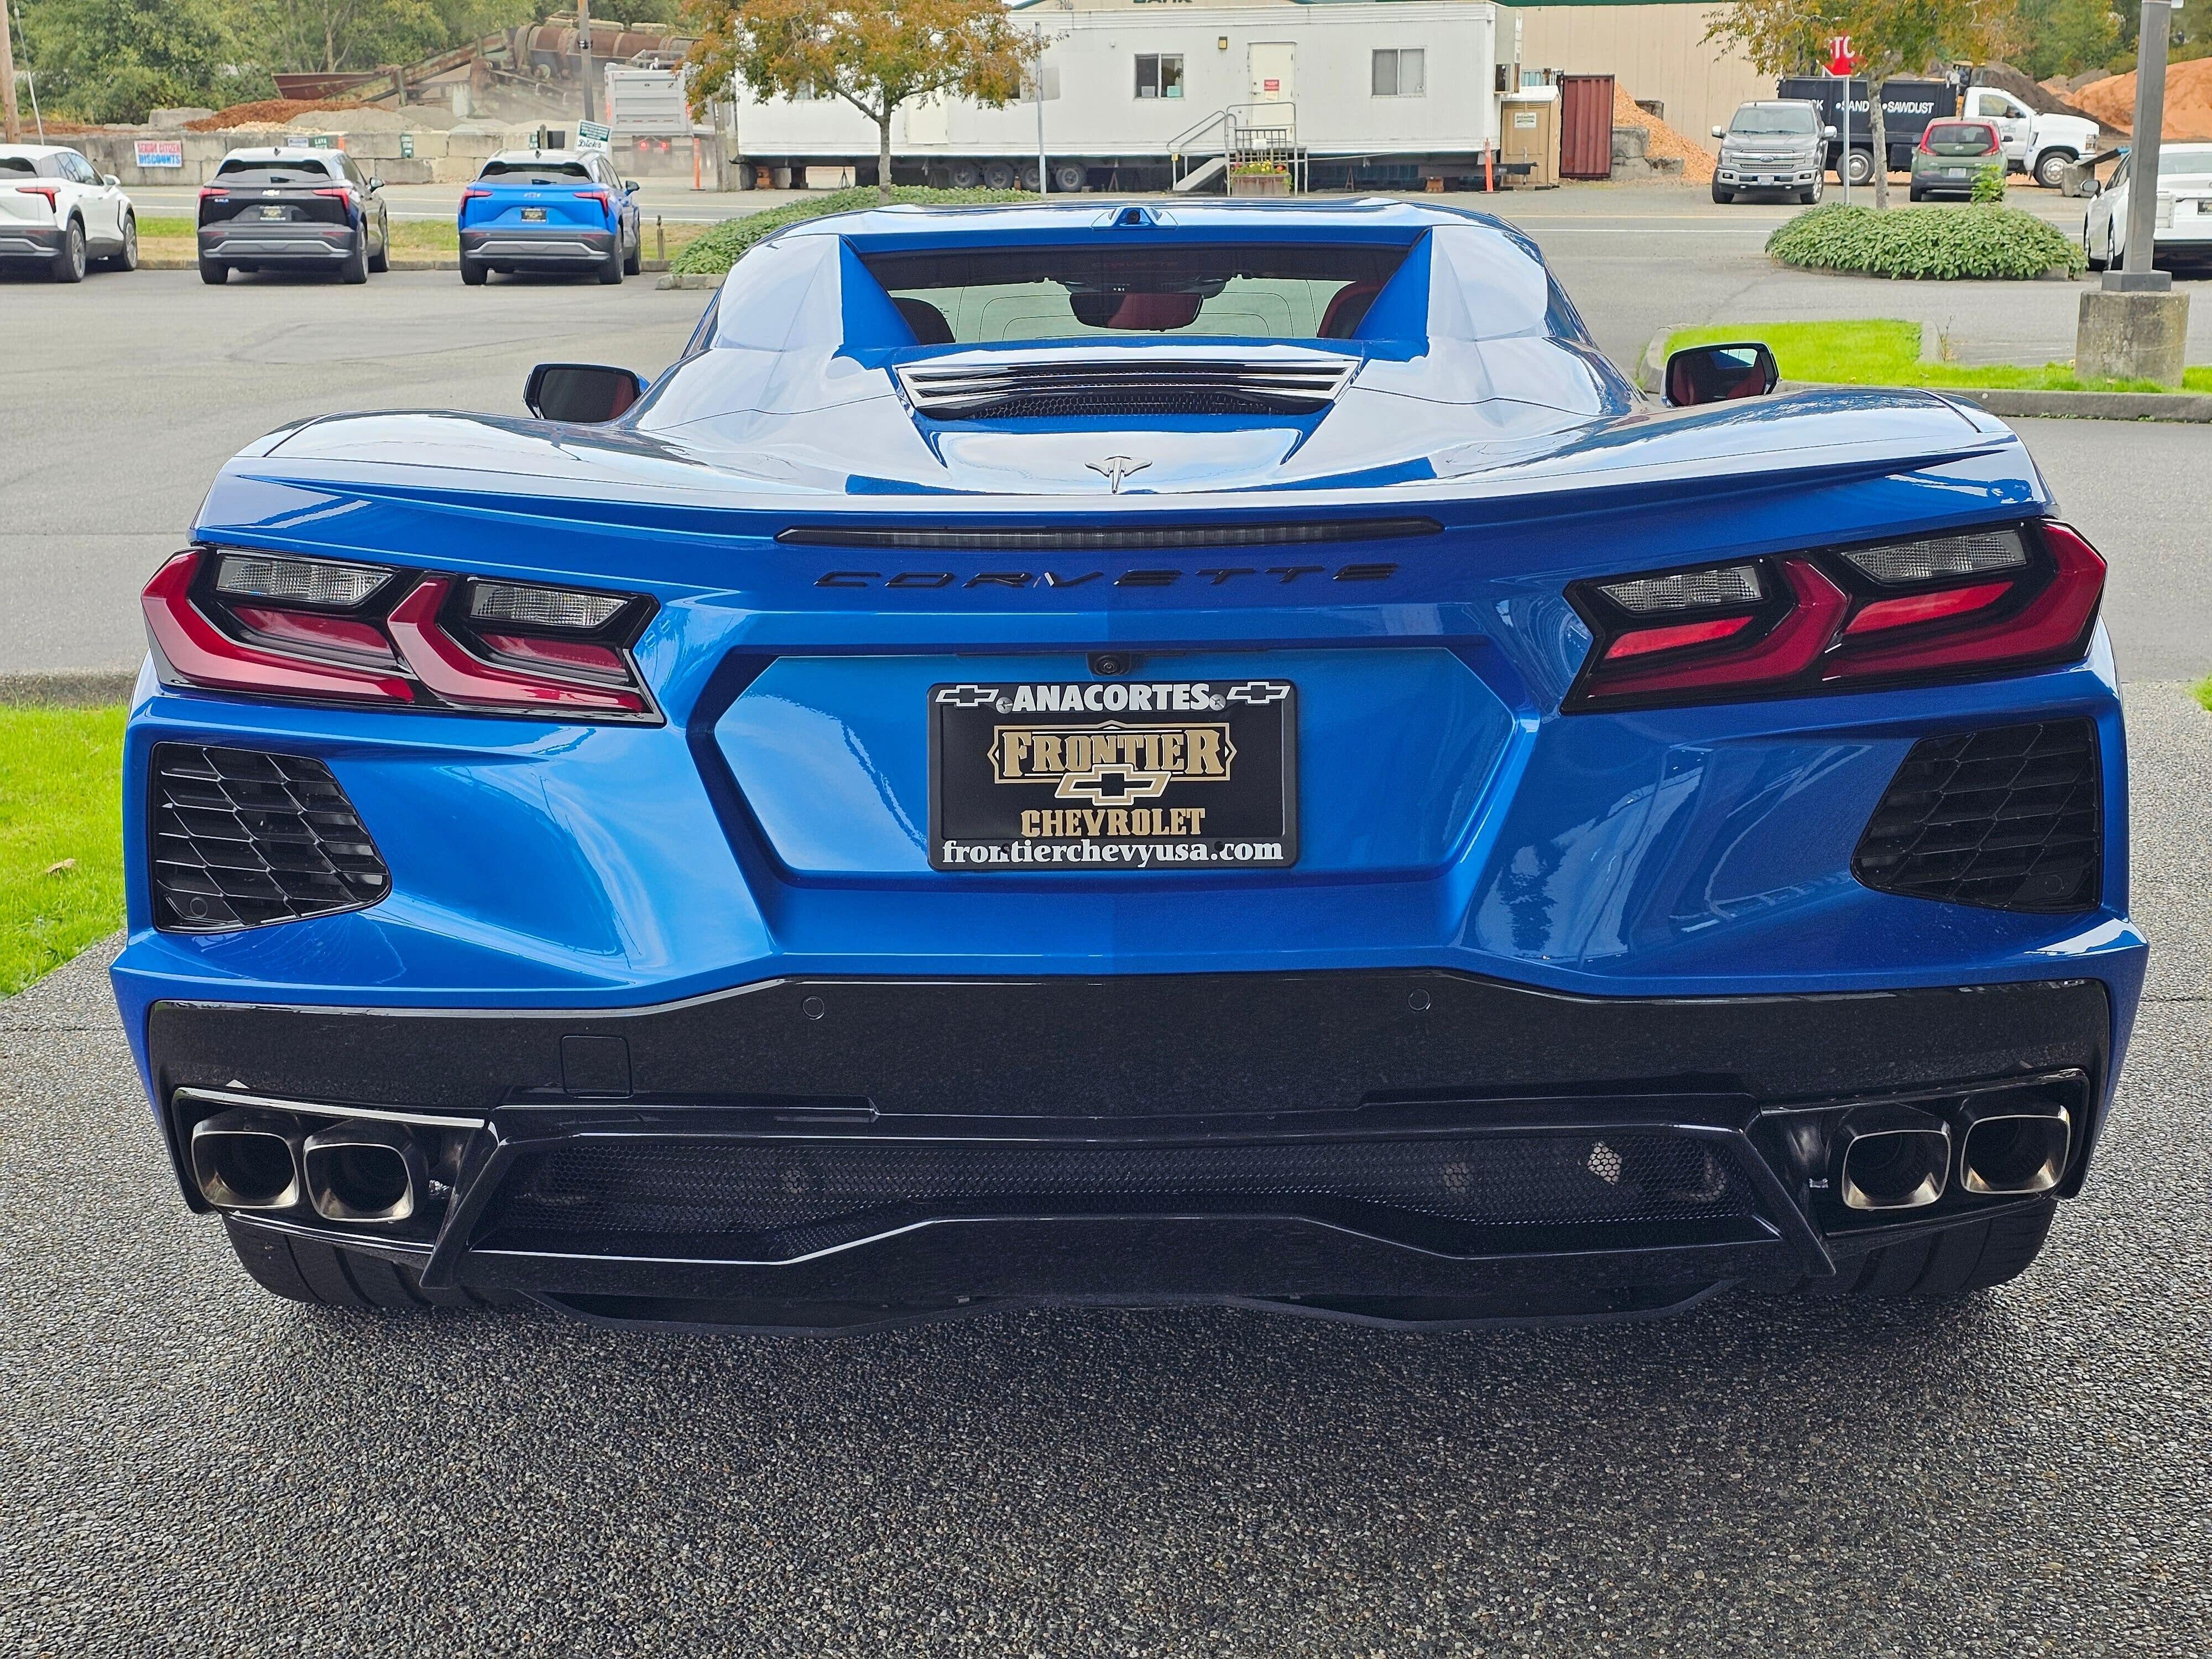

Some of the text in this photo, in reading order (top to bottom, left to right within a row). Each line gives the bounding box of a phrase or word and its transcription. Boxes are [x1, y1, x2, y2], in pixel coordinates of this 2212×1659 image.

[1887, 101, 1934, 114] SAWDUST
[139, 154, 181, 164] DISCOUNTS
[813, 562, 1399, 588] CORVETTE
[1011, 684, 1210, 712] ANACORTES
[1002, 729, 1224, 777] FRONTIER
[1020, 807, 1206, 837] CHEVROLET
[942, 839, 1284, 868] frontierchevyusa.com
